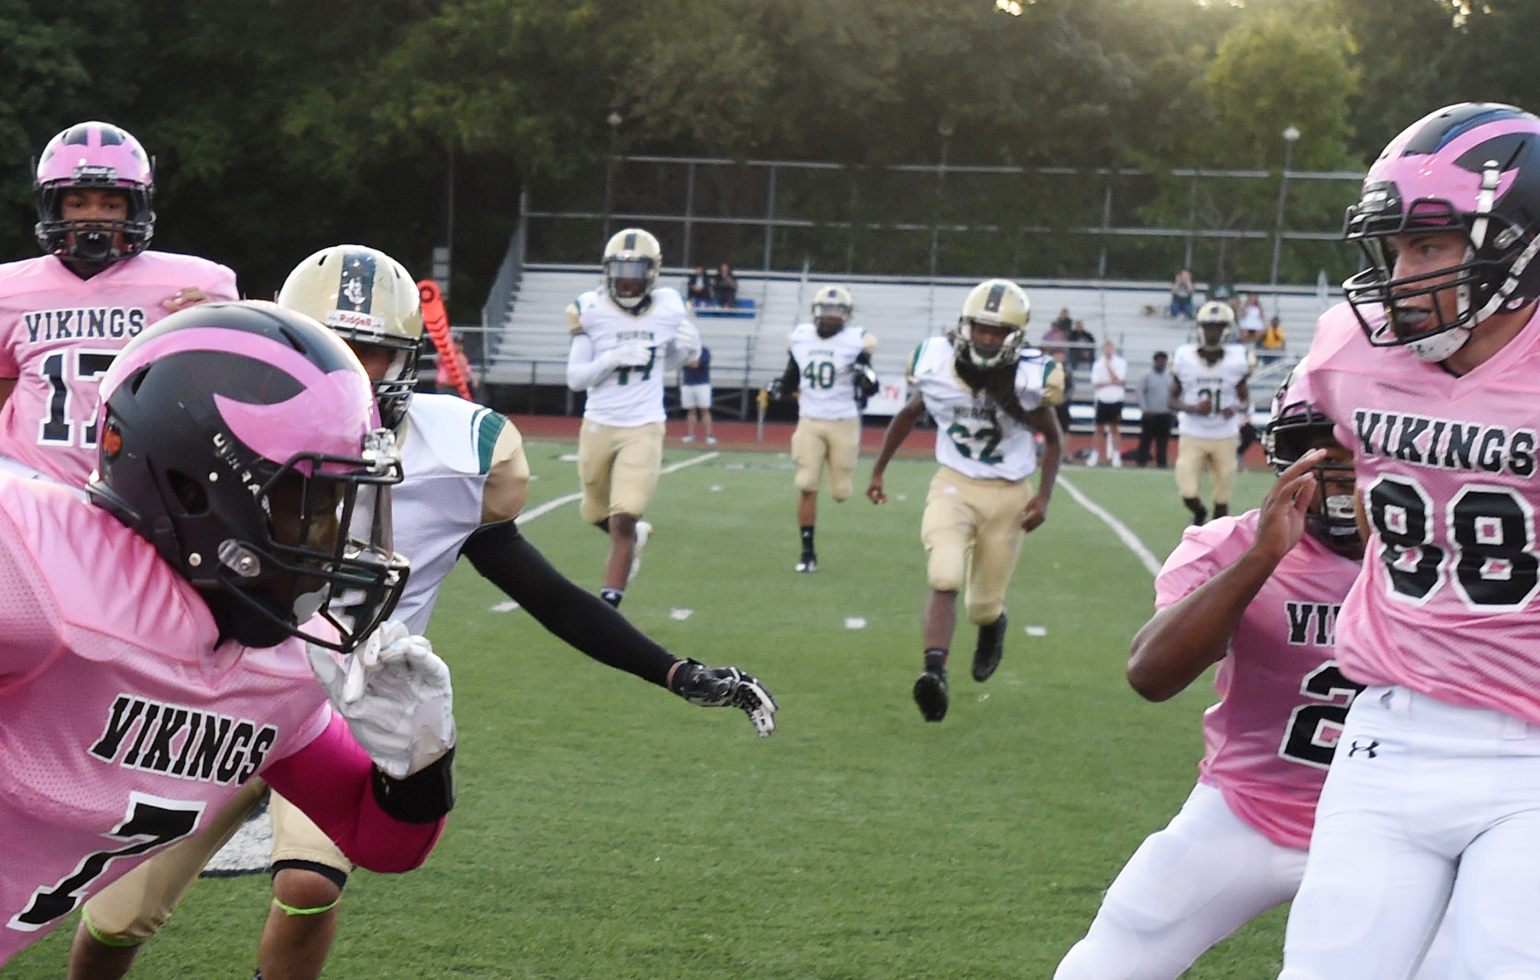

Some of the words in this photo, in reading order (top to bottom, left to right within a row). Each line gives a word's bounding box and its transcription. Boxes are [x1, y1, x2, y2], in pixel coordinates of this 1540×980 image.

[24, 307, 147, 344] VIKINGS
[804, 361, 835, 390] 40
[1352, 408, 1537, 479] VIKINGS
[1364, 473, 1540, 613] 88
[87, 693, 278, 786] VIKINGS
[6, 791, 206, 932] 7
